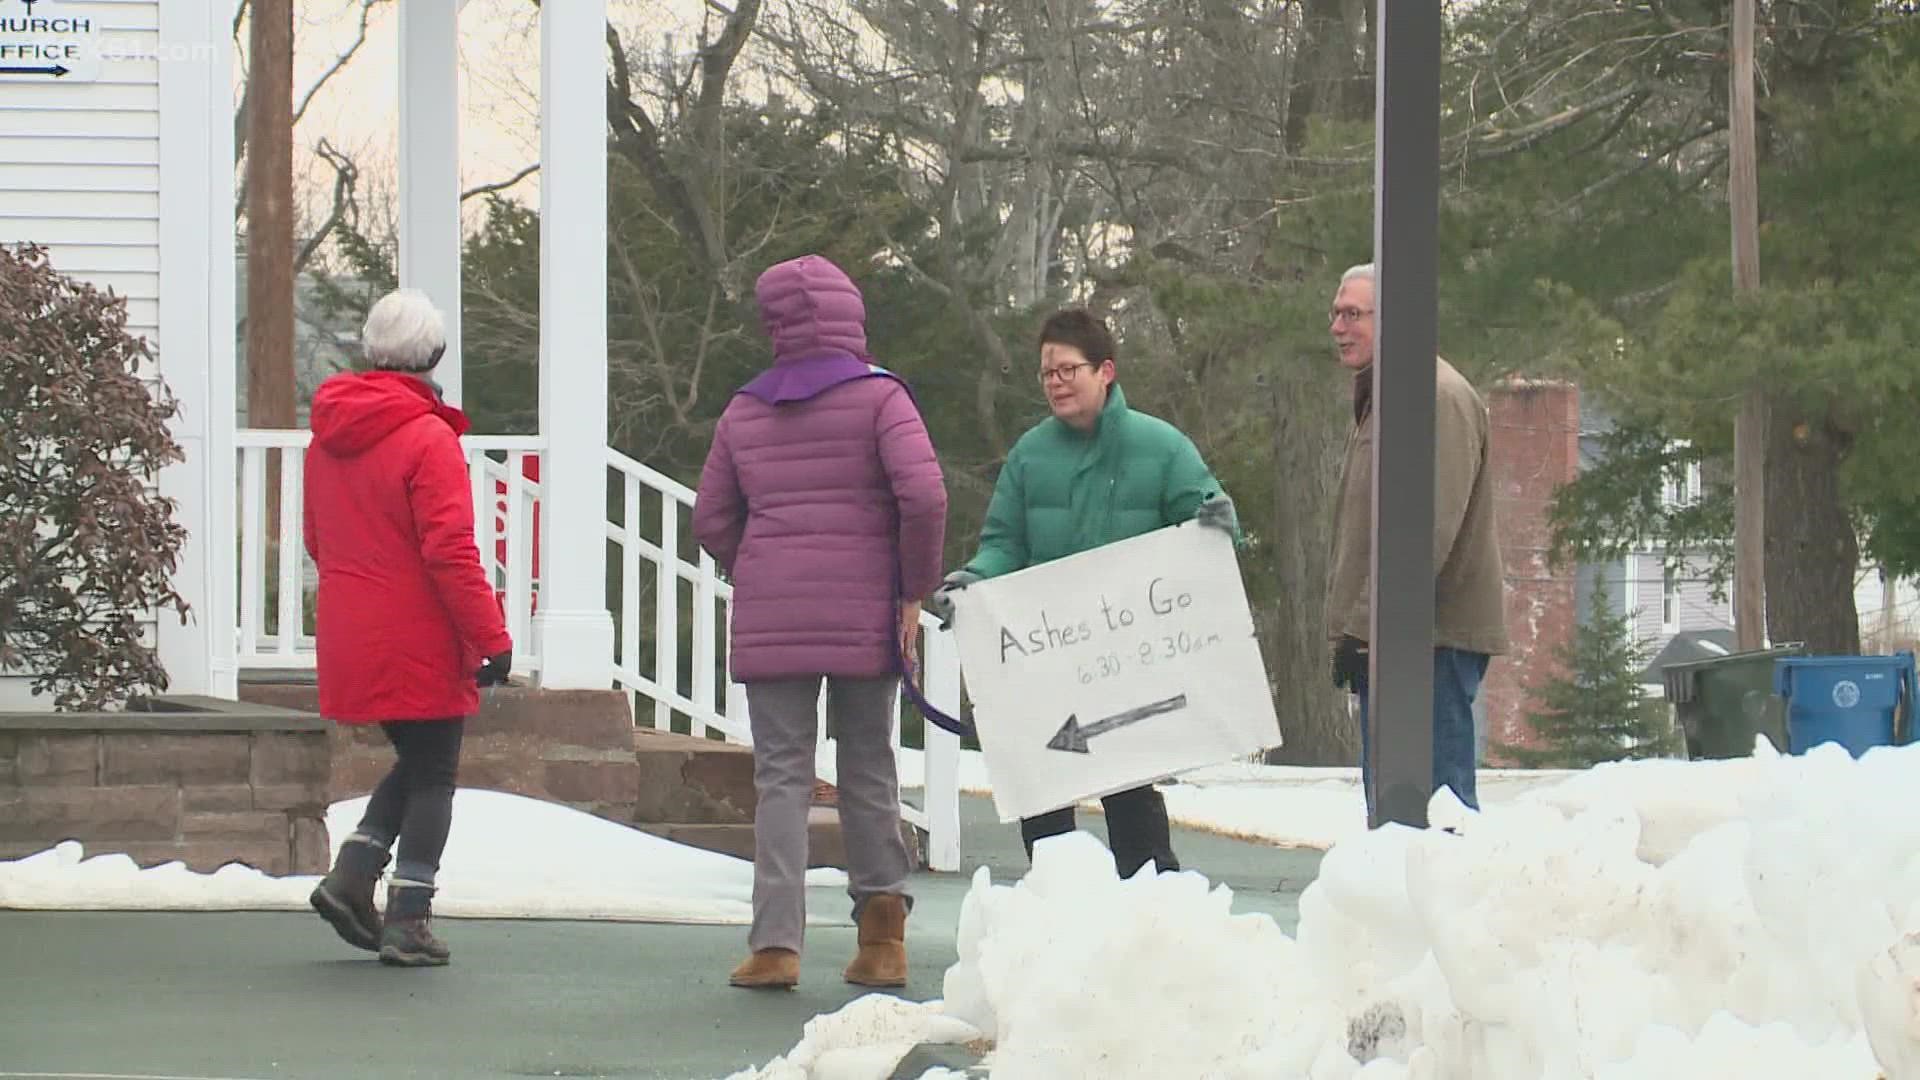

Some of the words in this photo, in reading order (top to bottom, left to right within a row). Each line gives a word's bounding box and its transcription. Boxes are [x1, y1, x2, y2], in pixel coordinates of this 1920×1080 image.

[0, 18, 90, 33] URCH
[0, 44, 80, 60] FFICE
[1000, 609, 1092, 664] Ashes
[1100, 594, 1135, 631] to
[1148, 577, 1193, 615] Go
